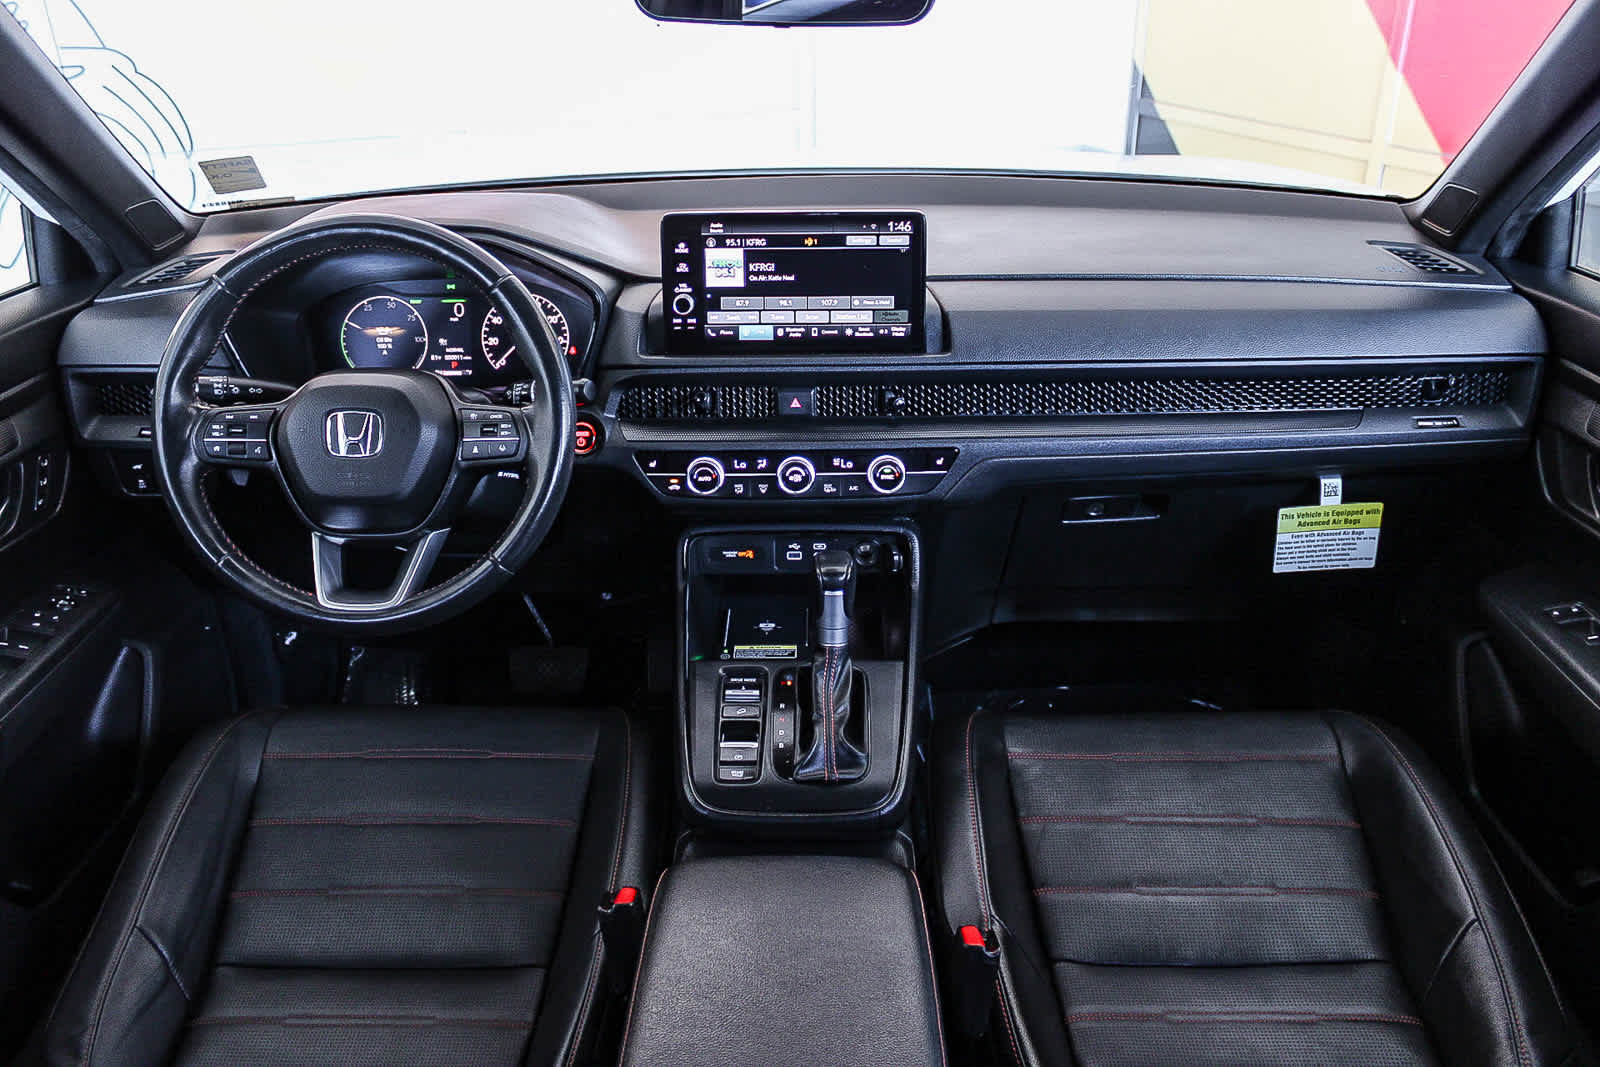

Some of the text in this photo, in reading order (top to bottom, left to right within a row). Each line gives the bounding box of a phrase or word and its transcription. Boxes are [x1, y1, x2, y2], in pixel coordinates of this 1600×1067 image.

[888, 221, 912, 232] 1:46
[725, 239, 767, 247] 95.1 KFRG
[749, 263, 775, 272] KFRG!
[386, 301, 396, 309] 50
[454, 302, 465, 318] 0
[407, 313, 416, 322] 75
[491, 316, 503, 325] 40
[488, 337, 499, 346] 20
[451, 361, 459, 369] P
[733, 459, 747, 469] Lo
[840, 458, 854, 469] Lo
[1280, 513, 1295, 521] This
[1297, 511, 1322, 519] Vehicle
[1331, 508, 1364, 518] Equipped
[1365, 507, 1381, 515] with
[1297, 519, 1330, 528] Advanced
[1343, 517, 1361, 526] Bags
